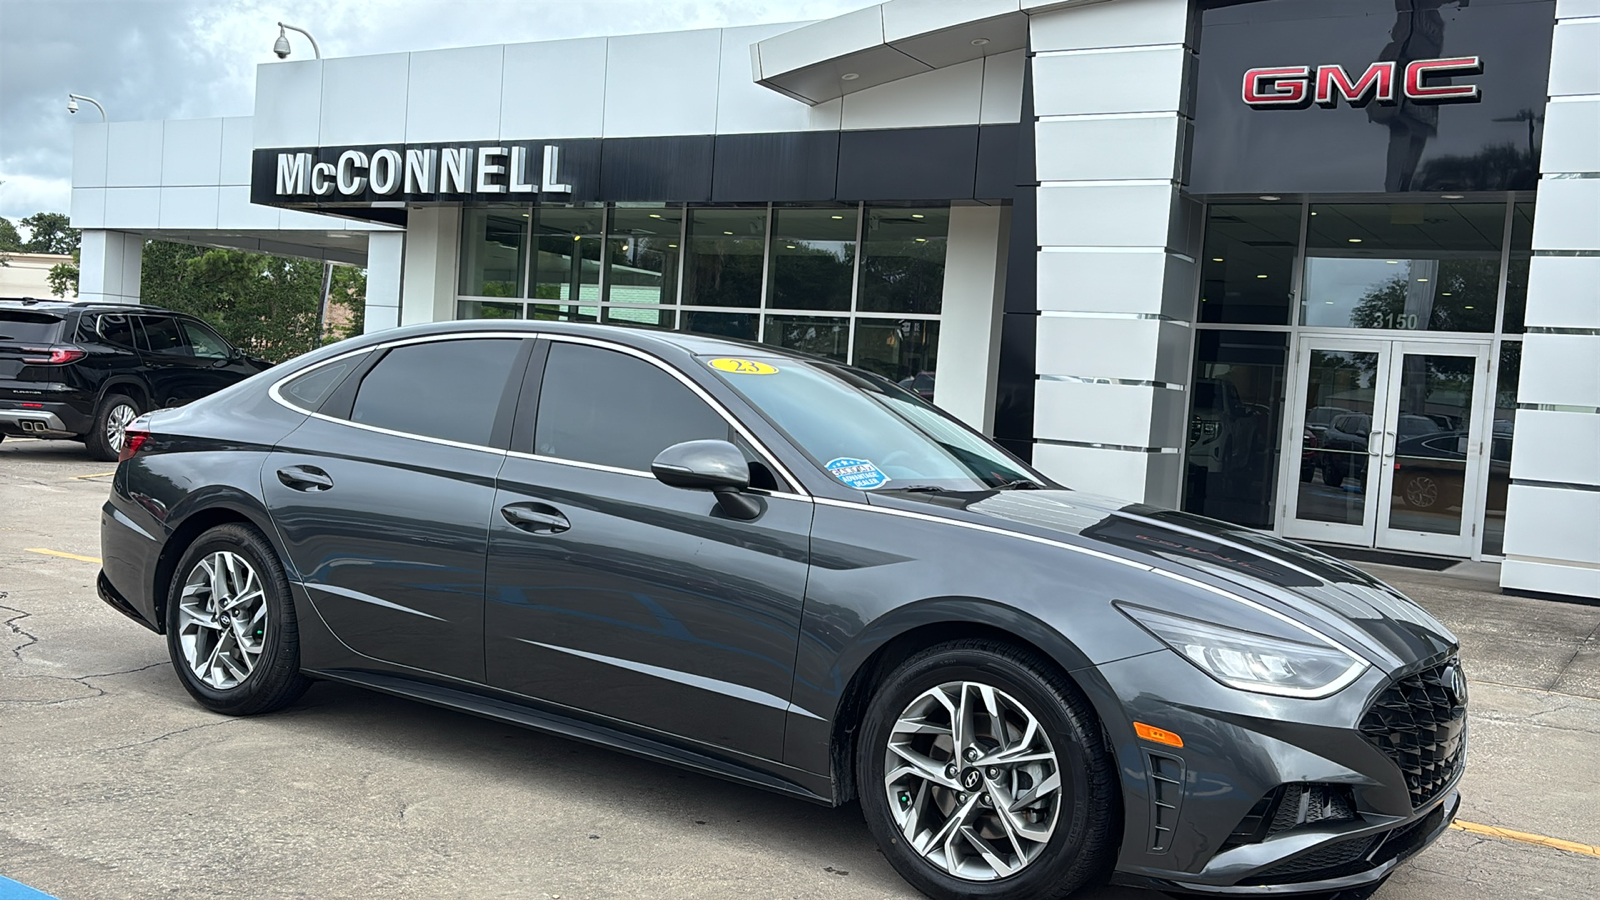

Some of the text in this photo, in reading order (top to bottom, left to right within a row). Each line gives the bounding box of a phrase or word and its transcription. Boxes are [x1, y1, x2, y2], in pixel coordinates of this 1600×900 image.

[1242, 55, 1482, 107] GMC
[276, 145, 572, 195] McCONNELL
[1373, 312, 1418, 330] 3150
[729, 360, 760, 372] 23
[841, 471, 880, 483] ADVANTAGE
[853, 477, 880, 487] DEALER
